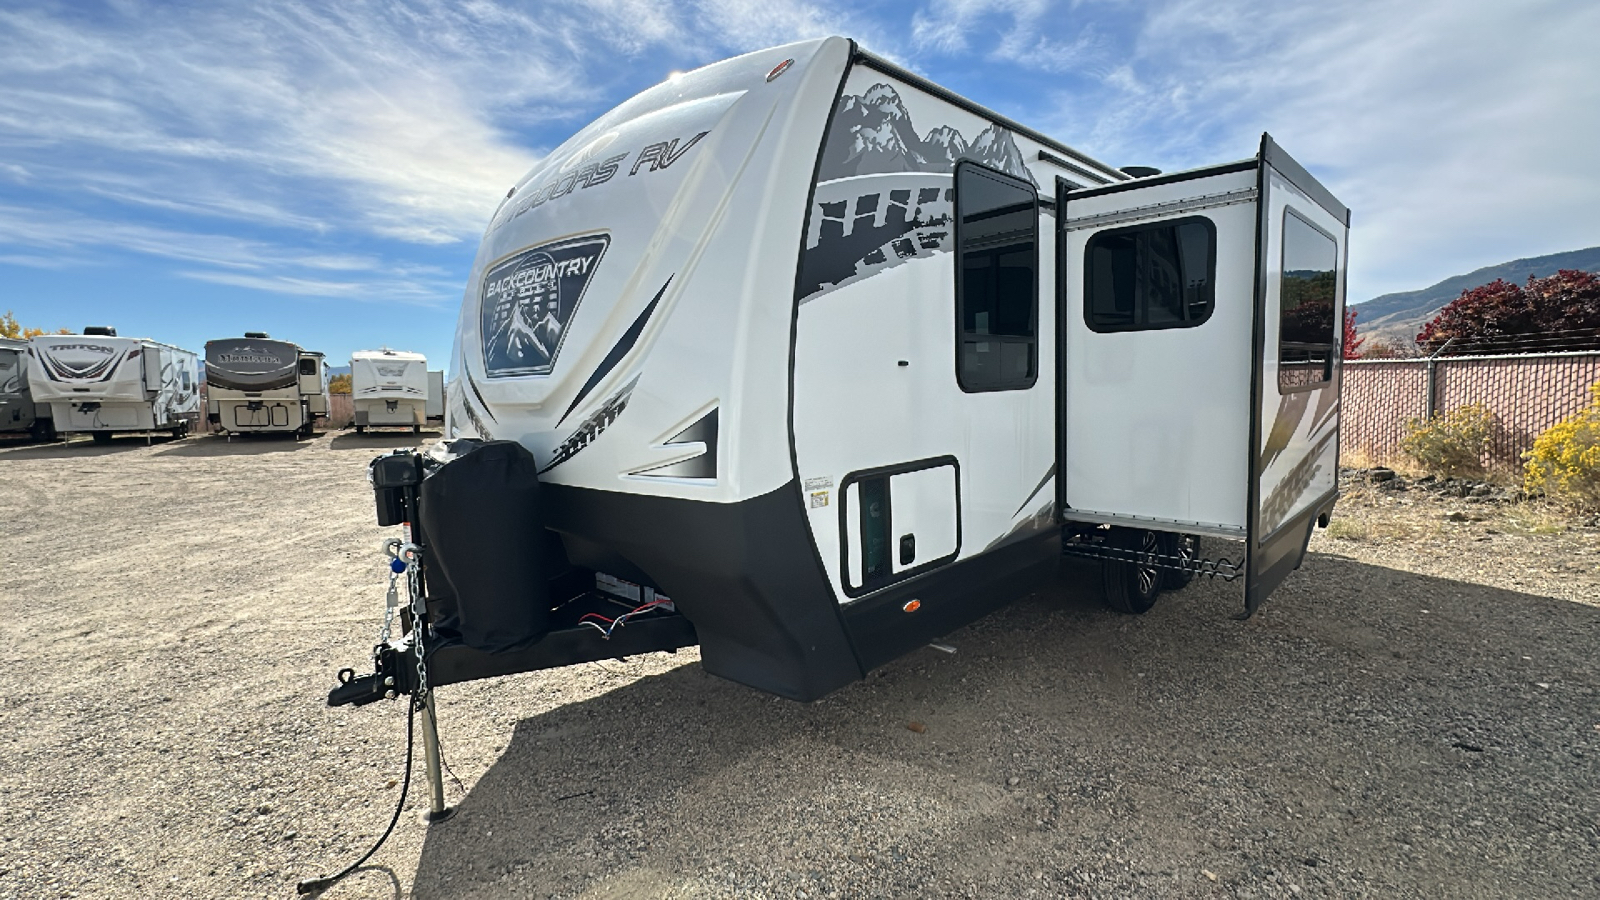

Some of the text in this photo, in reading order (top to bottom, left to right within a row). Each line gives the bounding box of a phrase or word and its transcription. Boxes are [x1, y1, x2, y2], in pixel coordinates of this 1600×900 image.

[628, 130, 711, 176] RV
[486, 254, 595, 298] BACKCOUNTRY
[49, 344, 114, 354] TRITON
